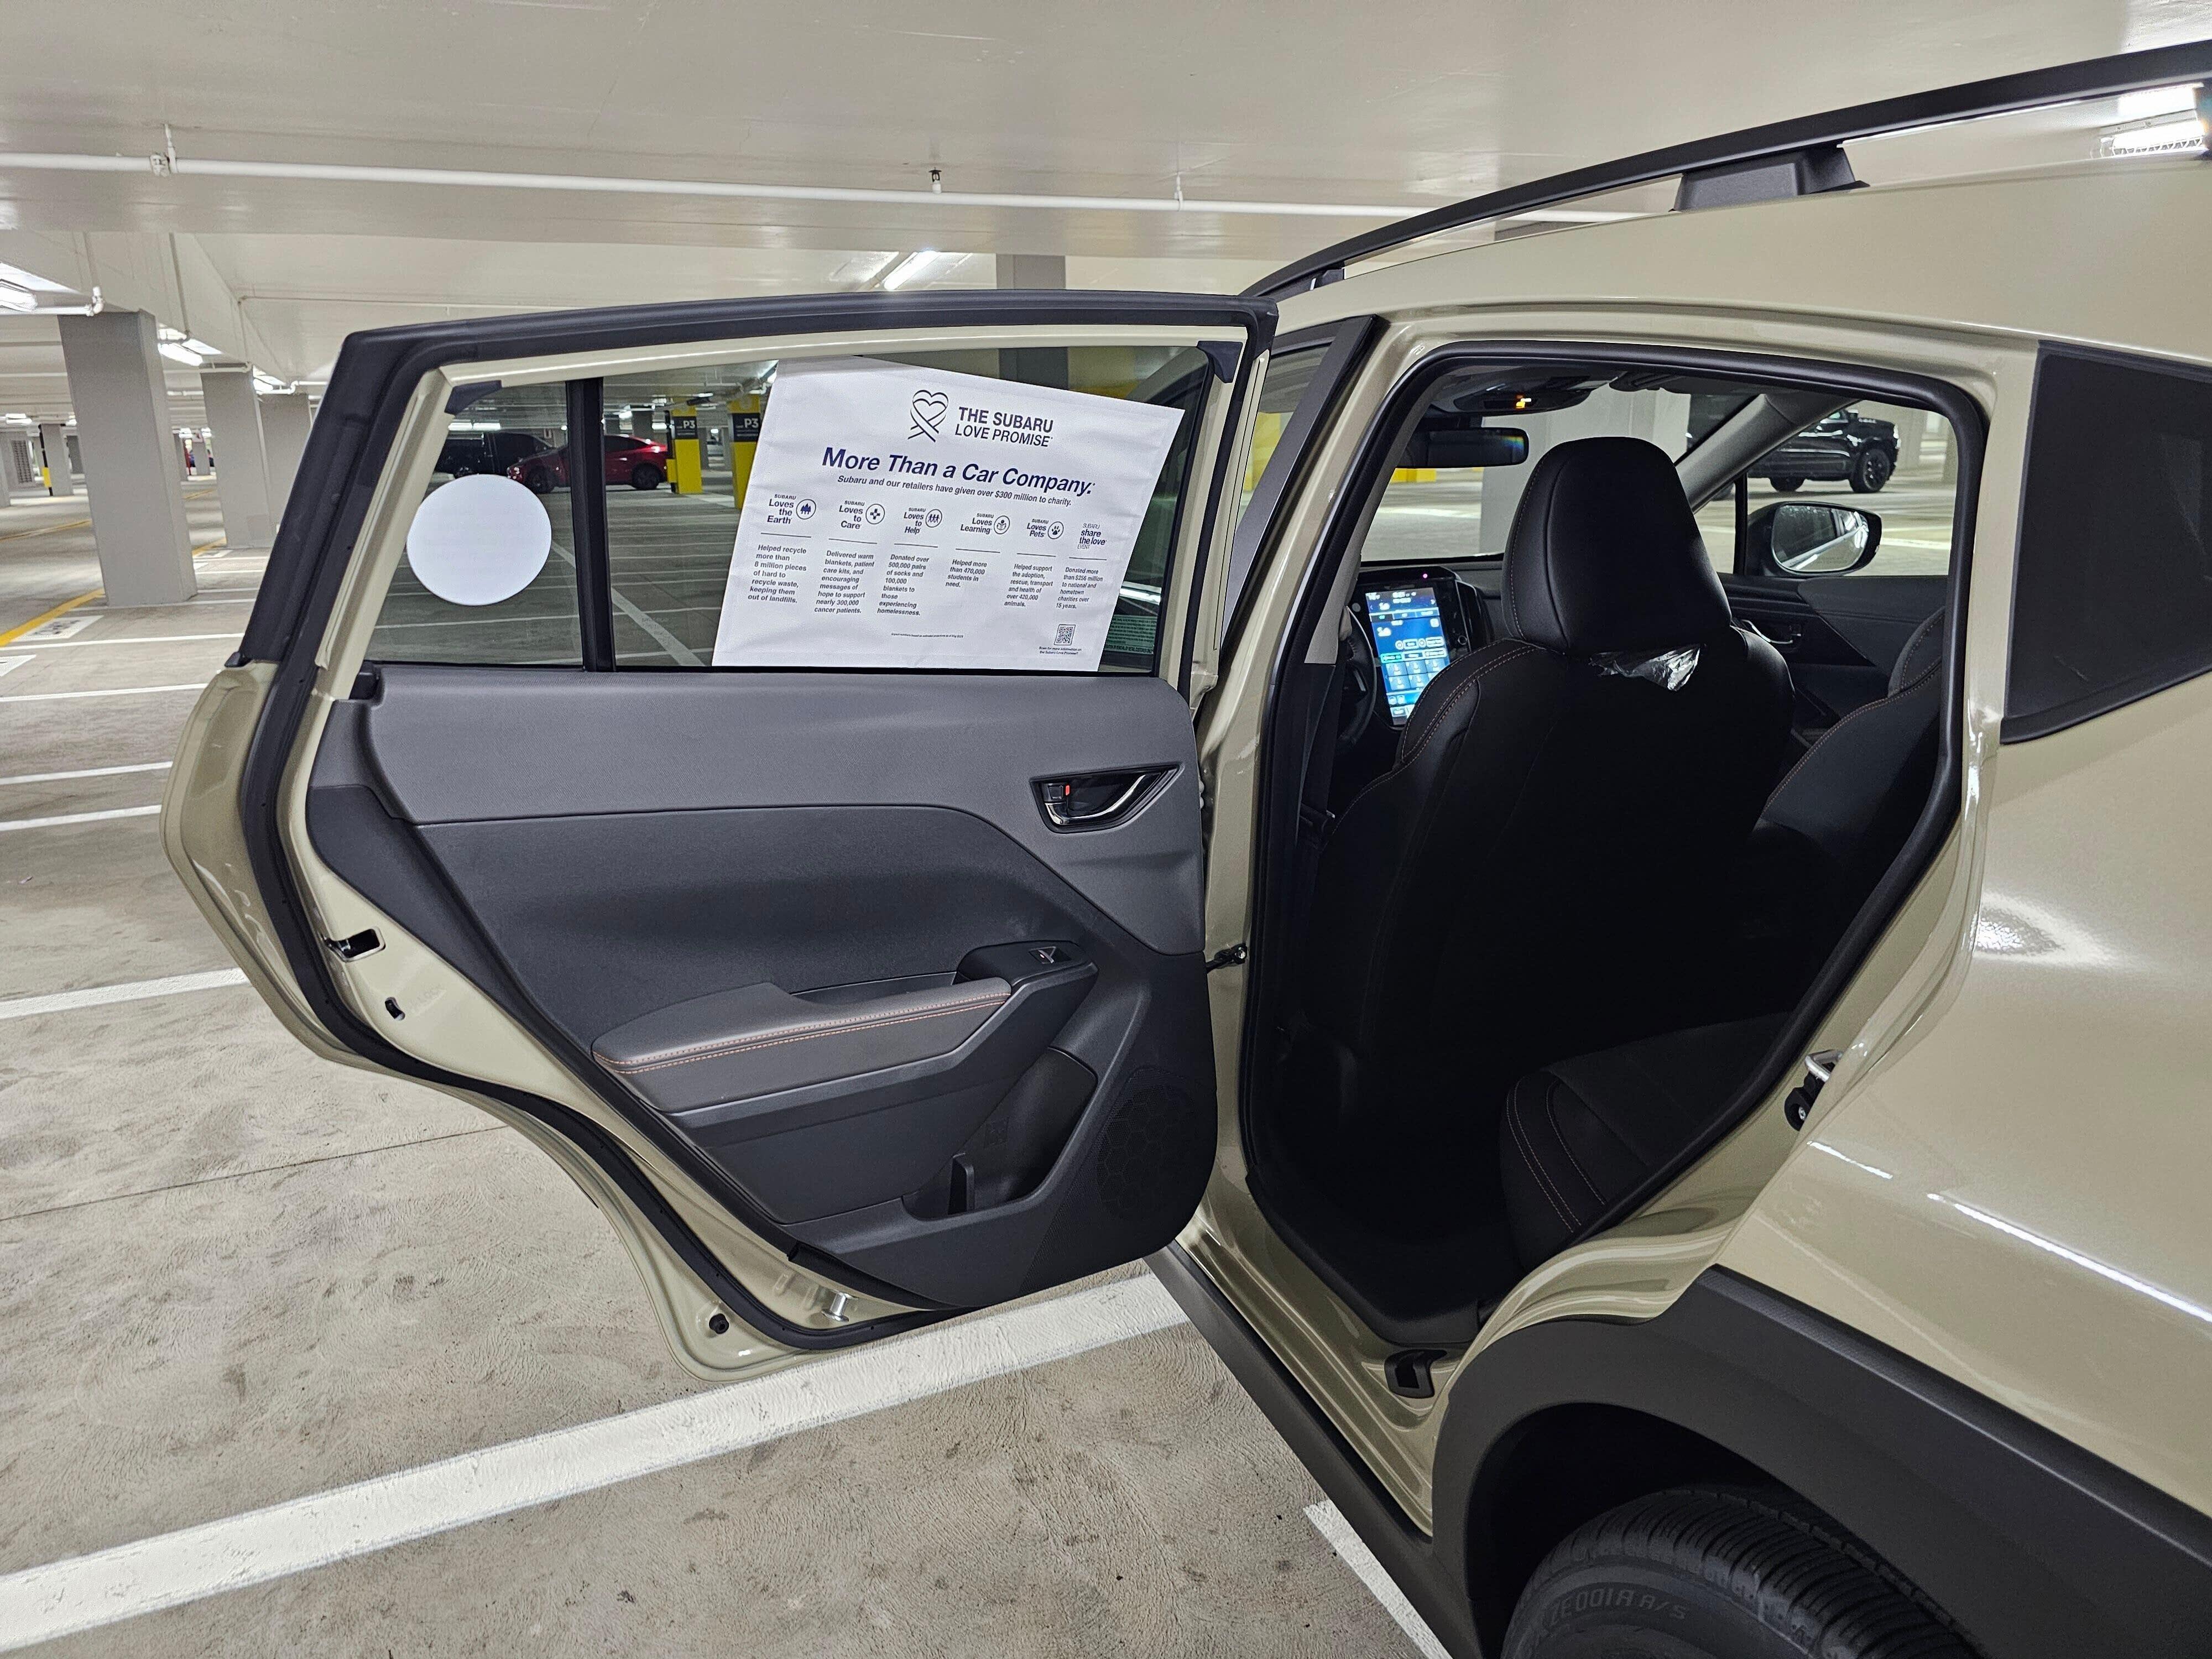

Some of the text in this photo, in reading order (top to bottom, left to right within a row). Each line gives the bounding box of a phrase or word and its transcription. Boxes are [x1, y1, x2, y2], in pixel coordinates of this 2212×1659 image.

[744, 418, 759, 429] P3
[958, 406, 1053, 433] THE SUBARU
[683, 420, 696, 429] P3
[954, 424, 990, 440] LOVE
[822, 447, 880, 471] More
[888, 454, 938, 476] Than
[942, 465, 956, 478] a
[962, 463, 999, 483] Car
[837, 475, 867, 484] Subaru
[902, 482, 933, 491] retailers
[935, 484, 953, 493] have
[954, 486, 975, 495] given
[994, 490, 1013, 499] $300
[1013, 493, 1037, 502] million
[1048, 497, 1071, 507] charity.
[769, 498, 794, 508] Loves
[779, 508, 792, 516] the
[839, 505, 863, 514] Loves
[904, 512, 924, 520] Loves
[972, 517, 993, 526] Loves
[1026, 523, 1047, 531] Loves
[1081, 529, 1102, 537] share
[1079, 536, 1091, 545] the
[758, 544, 781, 552] Helped
[826, 550, 857, 559] Delivered
[825, 559, 853, 567] blankets,
[749, 586, 777, 595] keeping
[769, 595, 797, 603] landfills.
[879, 601, 917, 609] experiencing
